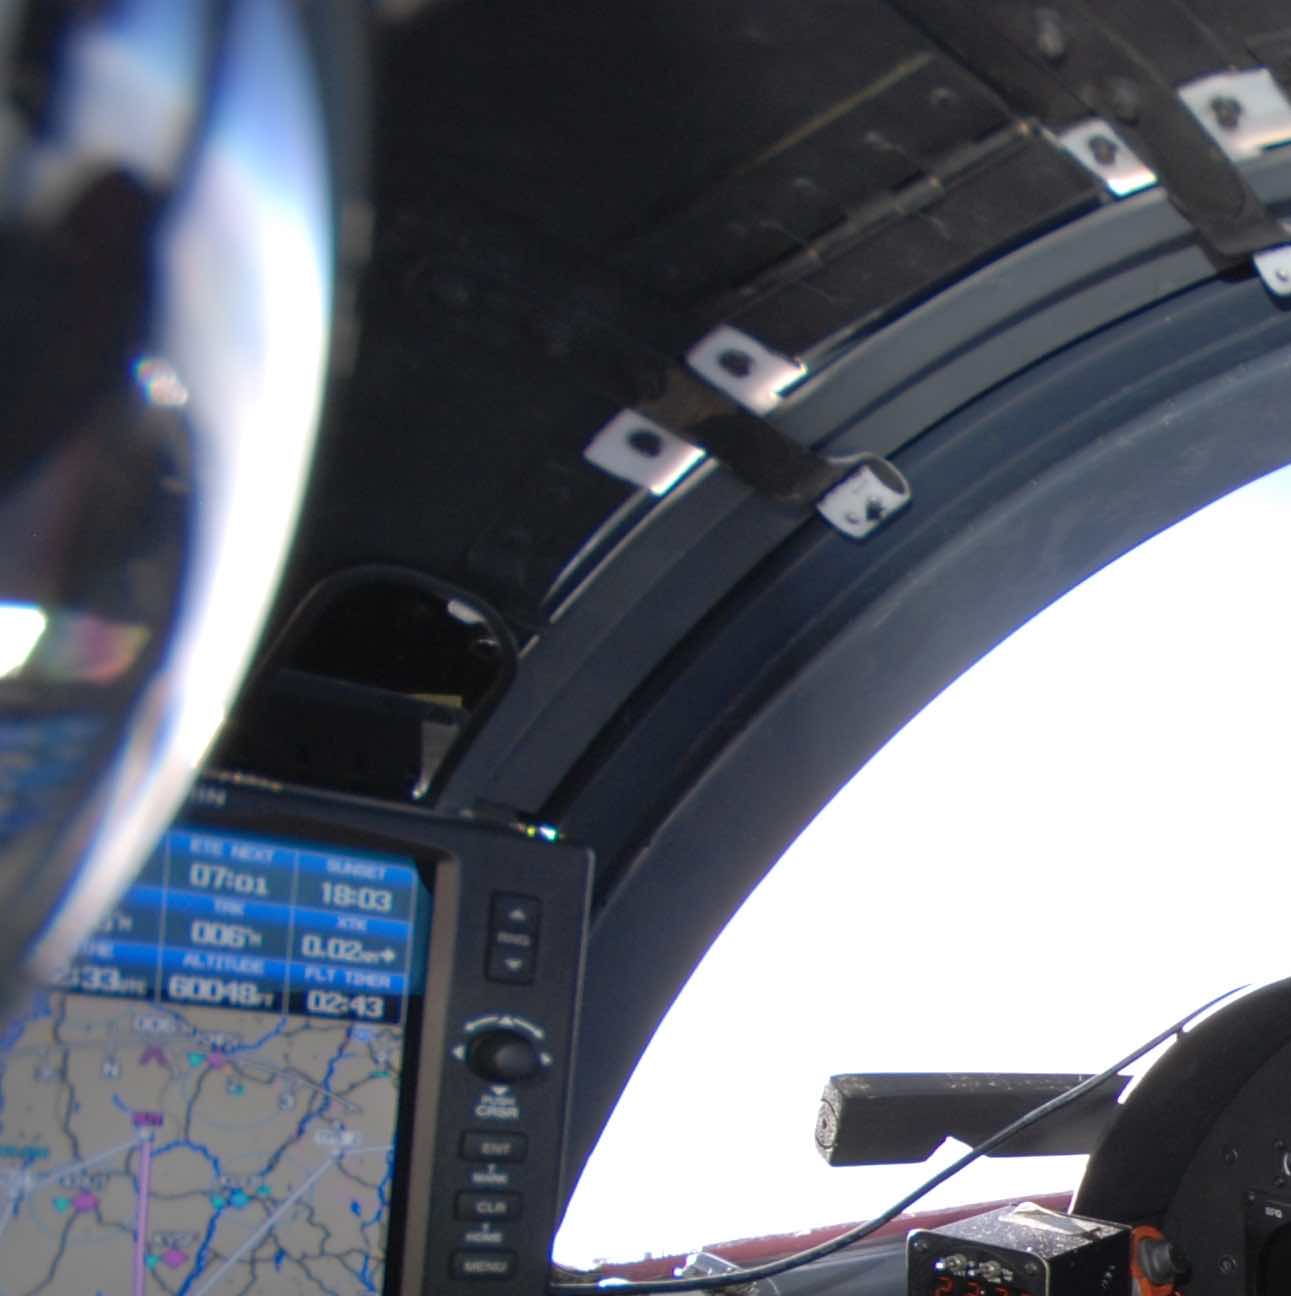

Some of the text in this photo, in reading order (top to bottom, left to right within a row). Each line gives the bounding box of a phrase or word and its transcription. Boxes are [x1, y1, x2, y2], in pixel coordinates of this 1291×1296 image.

[190, 863, 268, 897] 07:01
[321, 880, 393, 912] 18:03
[306, 988, 385, 1019] 02:43
[463, 1259, 508, 1274] MENU
